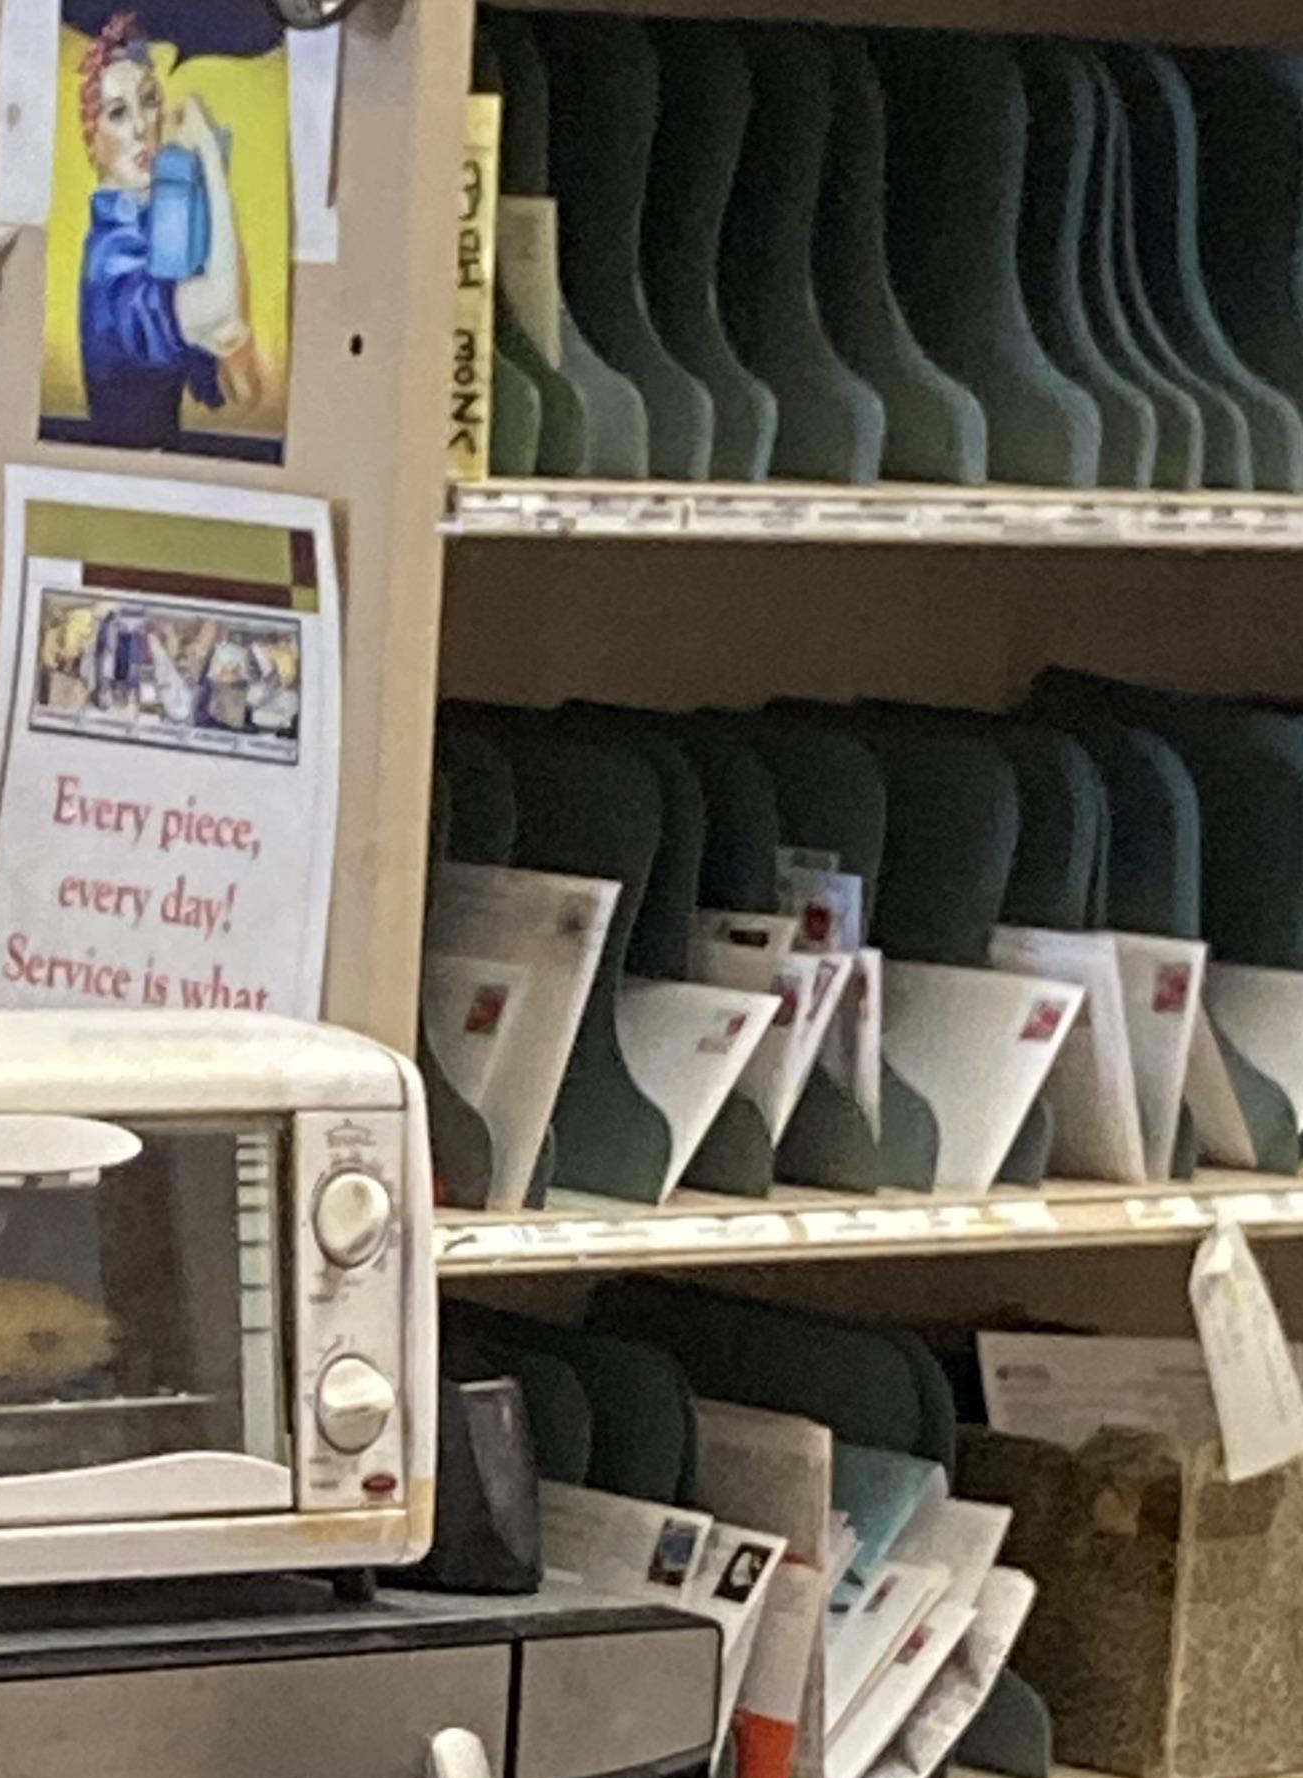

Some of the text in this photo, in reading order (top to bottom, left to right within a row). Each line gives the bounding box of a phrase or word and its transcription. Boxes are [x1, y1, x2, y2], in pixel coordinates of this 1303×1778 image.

[54, 774, 261, 861] Every piece,
[58, 873, 236, 941] every day!
[3, 932, 270, 1011] Service is what
